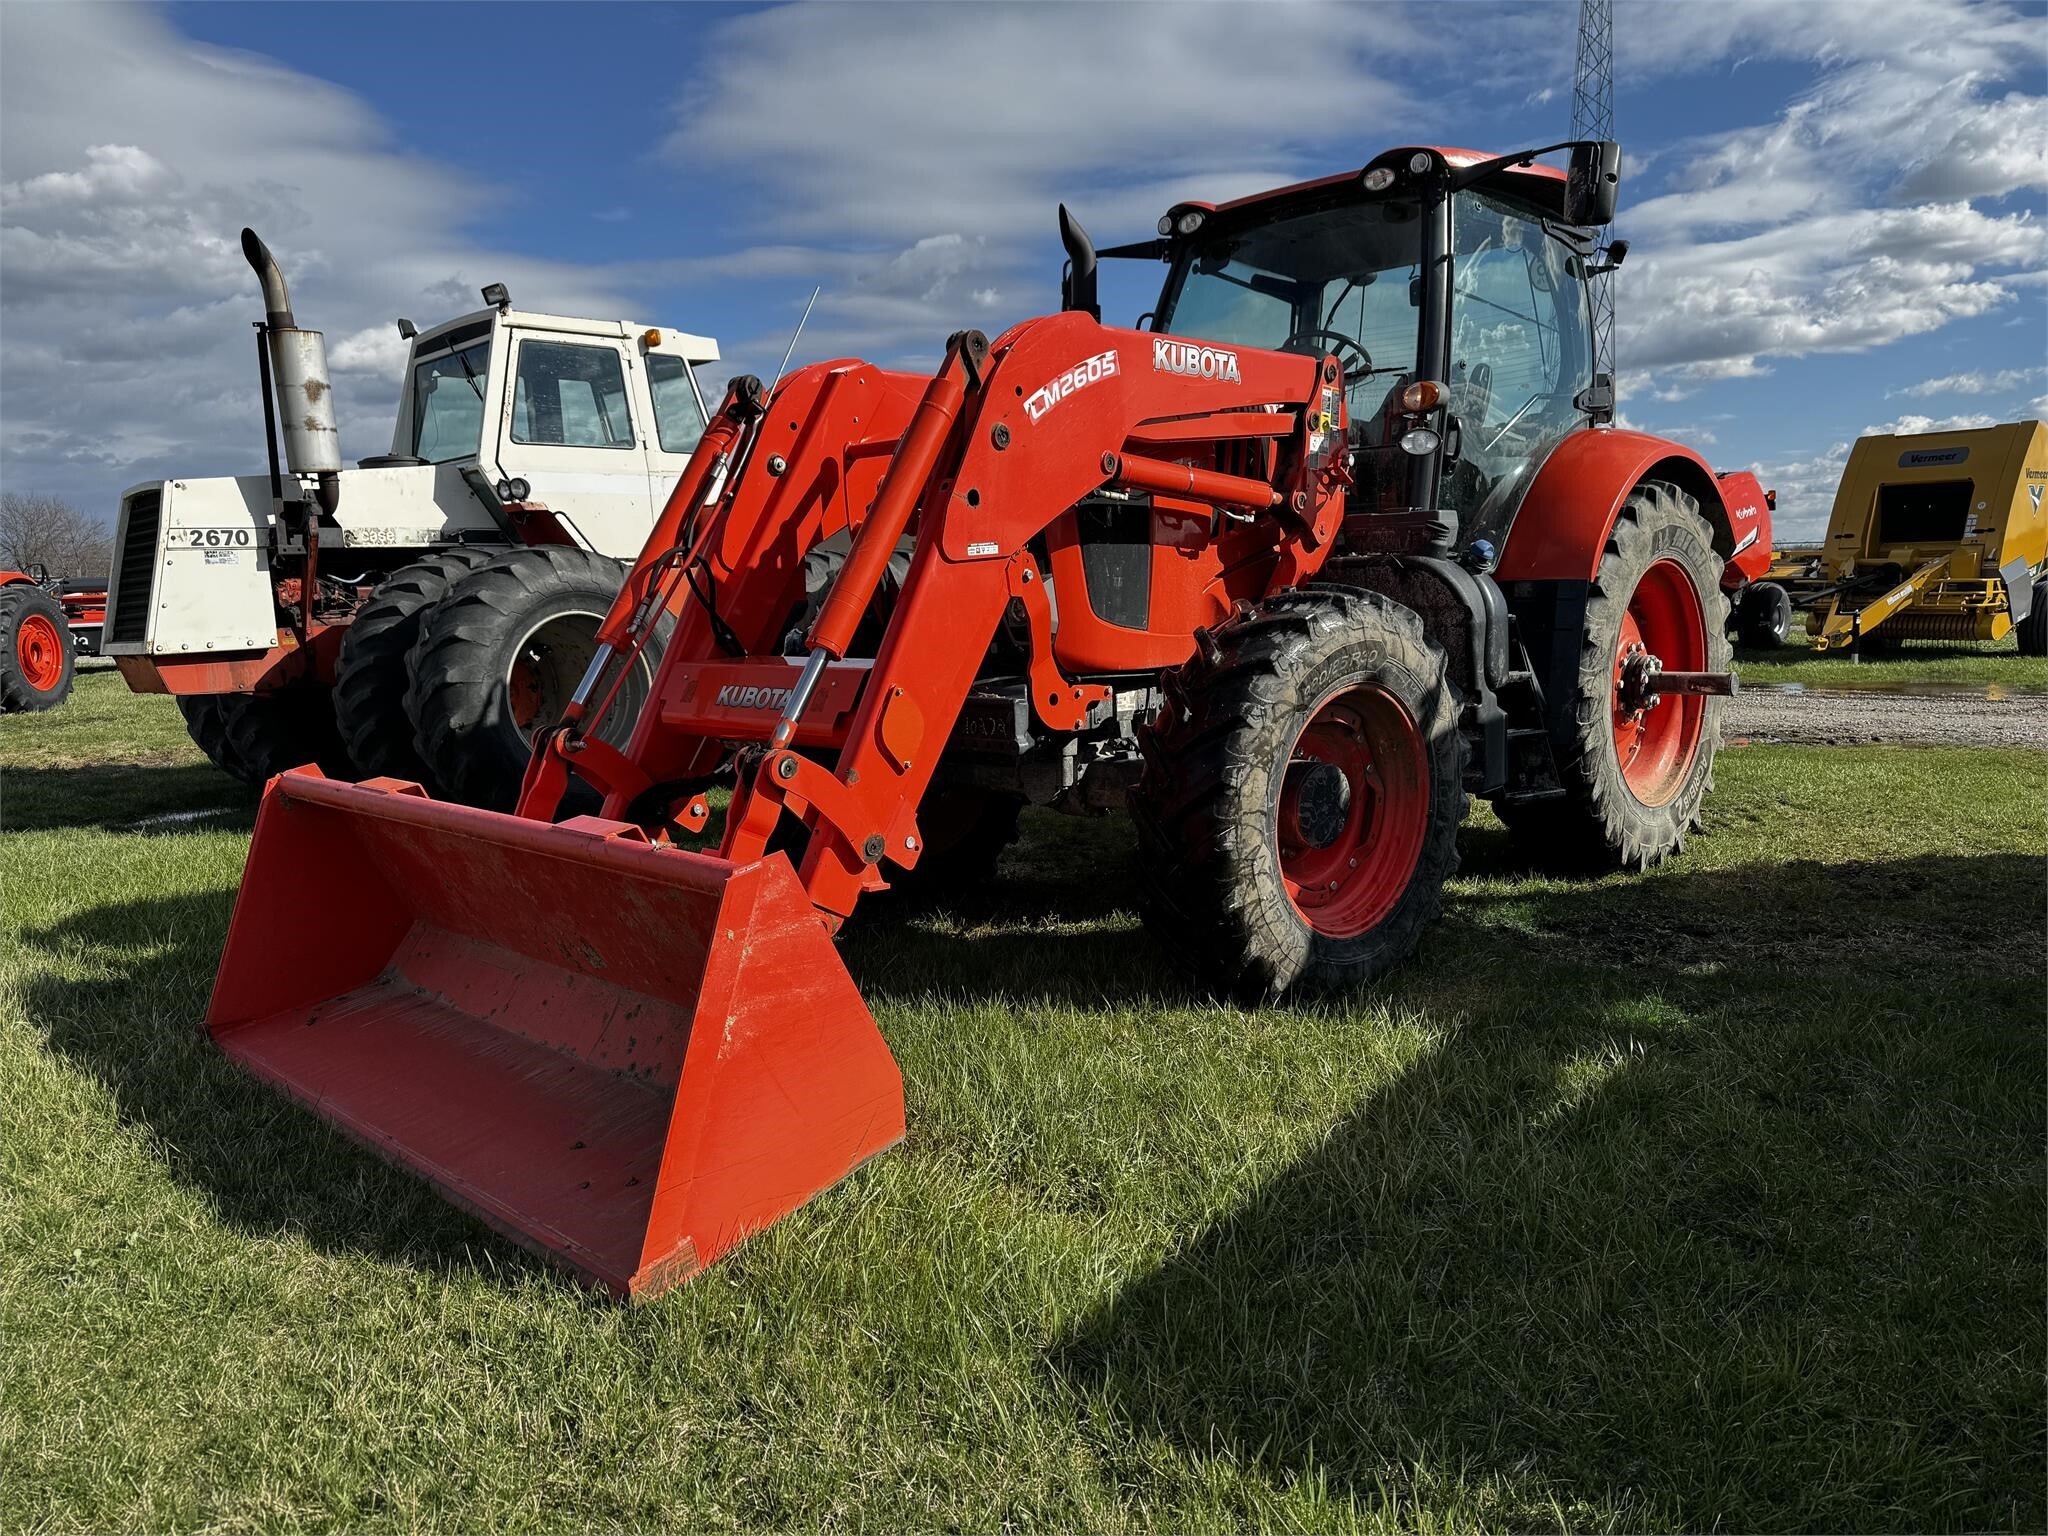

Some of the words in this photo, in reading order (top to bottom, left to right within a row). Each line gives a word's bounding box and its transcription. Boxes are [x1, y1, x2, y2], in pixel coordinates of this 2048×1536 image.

[1154, 339, 1240, 384] KUBOTA
[1027, 352, 1117, 421] LM2605
[1911, 453, 1957, 463] Vermeer
[190, 529, 249, 546] 2670
[716, 685, 793, 710] KUBOTA
